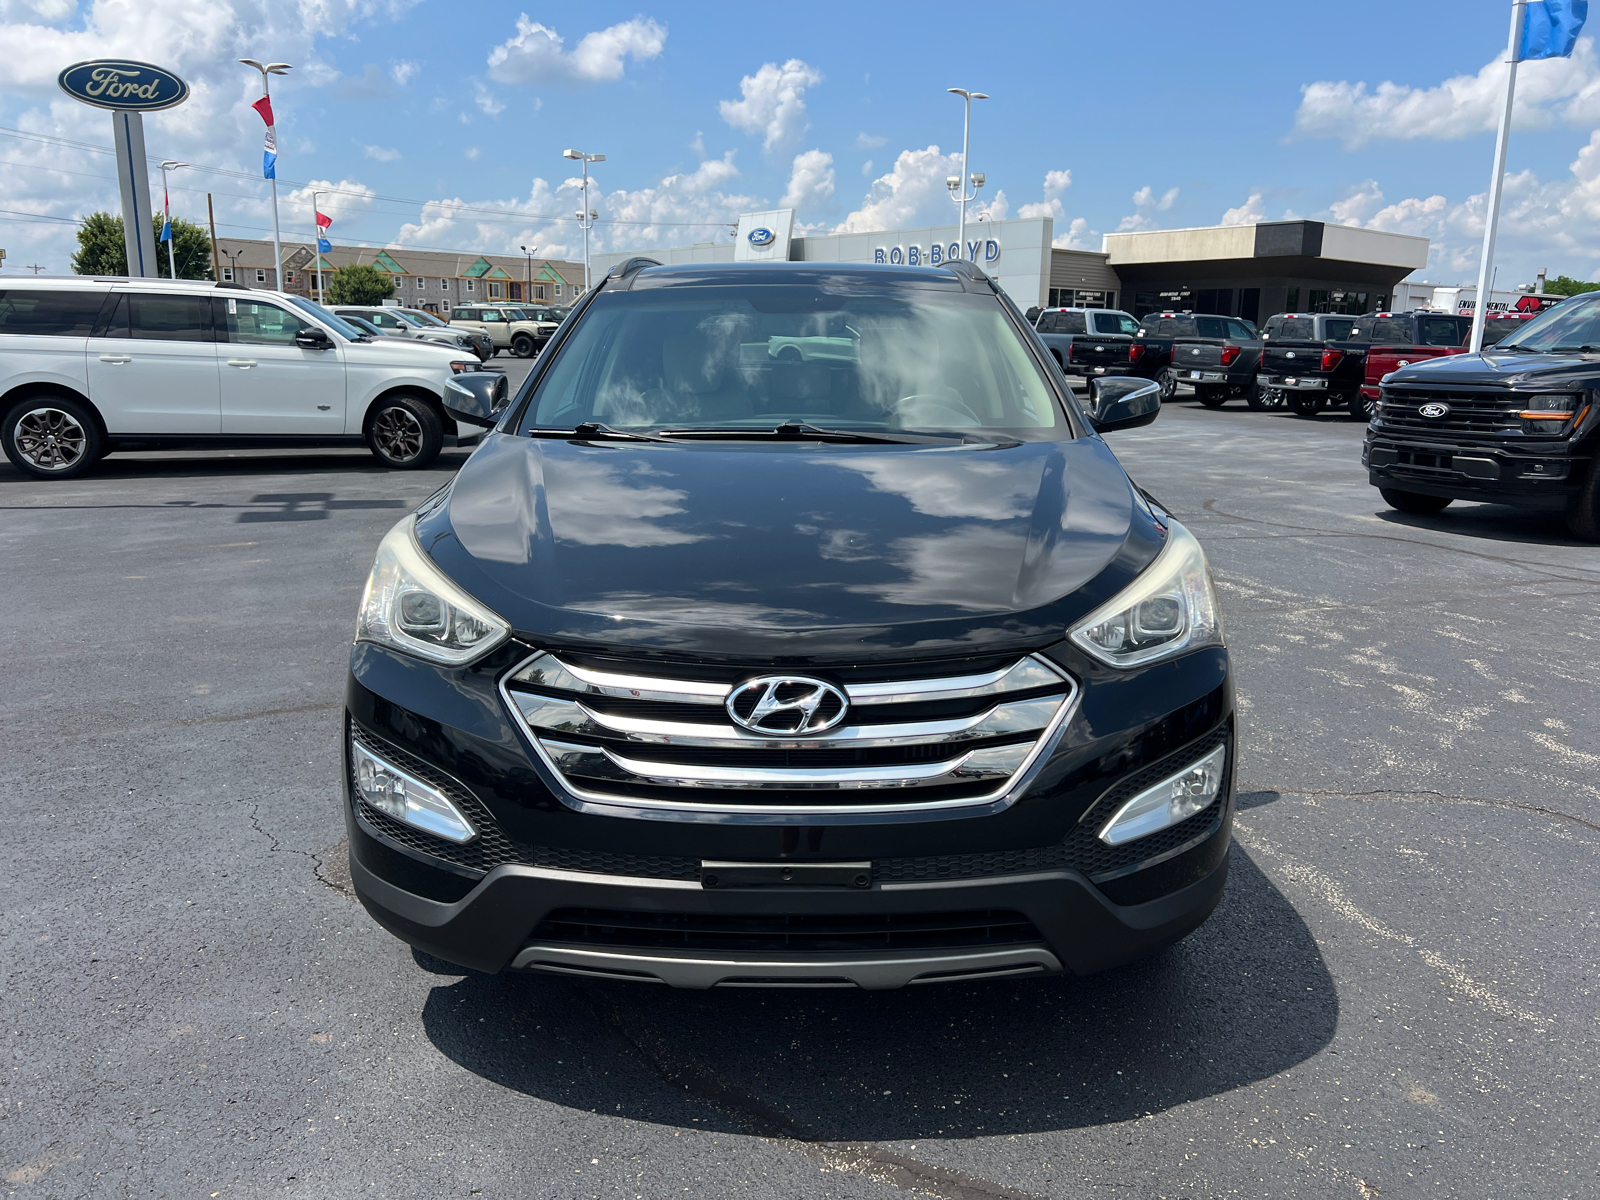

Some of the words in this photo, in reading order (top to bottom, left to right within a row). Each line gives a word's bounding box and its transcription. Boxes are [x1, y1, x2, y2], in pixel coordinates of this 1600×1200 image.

[85, 67, 160, 99] Ford
[751, 230, 768, 241] Ford
[874, 240, 999, 267] BOB-BOYD
[1423, 405, 1441, 416] Ford
